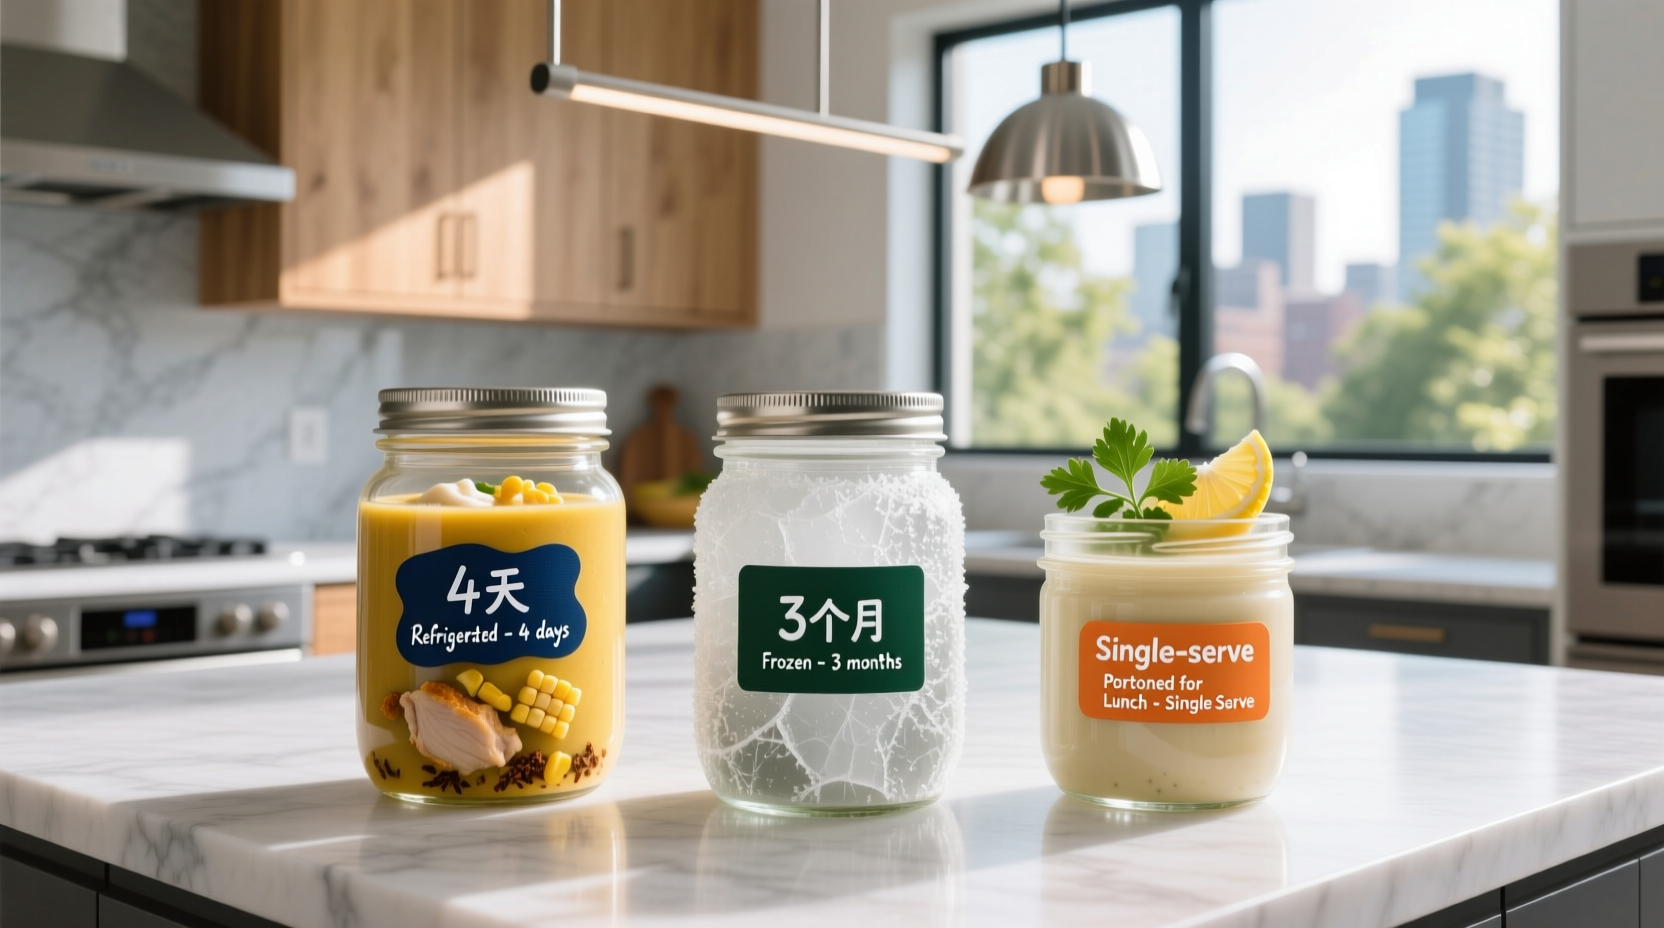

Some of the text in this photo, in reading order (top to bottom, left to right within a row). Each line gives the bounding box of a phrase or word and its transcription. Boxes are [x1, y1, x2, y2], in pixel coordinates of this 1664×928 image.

[446, 565, 530, 615] 4天
[518, 623, 530, 642] 4
[535, 619, 570, 648] days
[778, 595, 883, 643] 3个月
[762, 651, 812, 670] Frozen
[831, 653, 842, 671] 3
[847, 652, 902, 670] months
[1095, 635, 1255, 671] Single-serve
[1103, 673, 1204, 691] Portoned for
[1103, 693, 1148, 710] Lunch
[1165, 695, 1213, 715] Single
